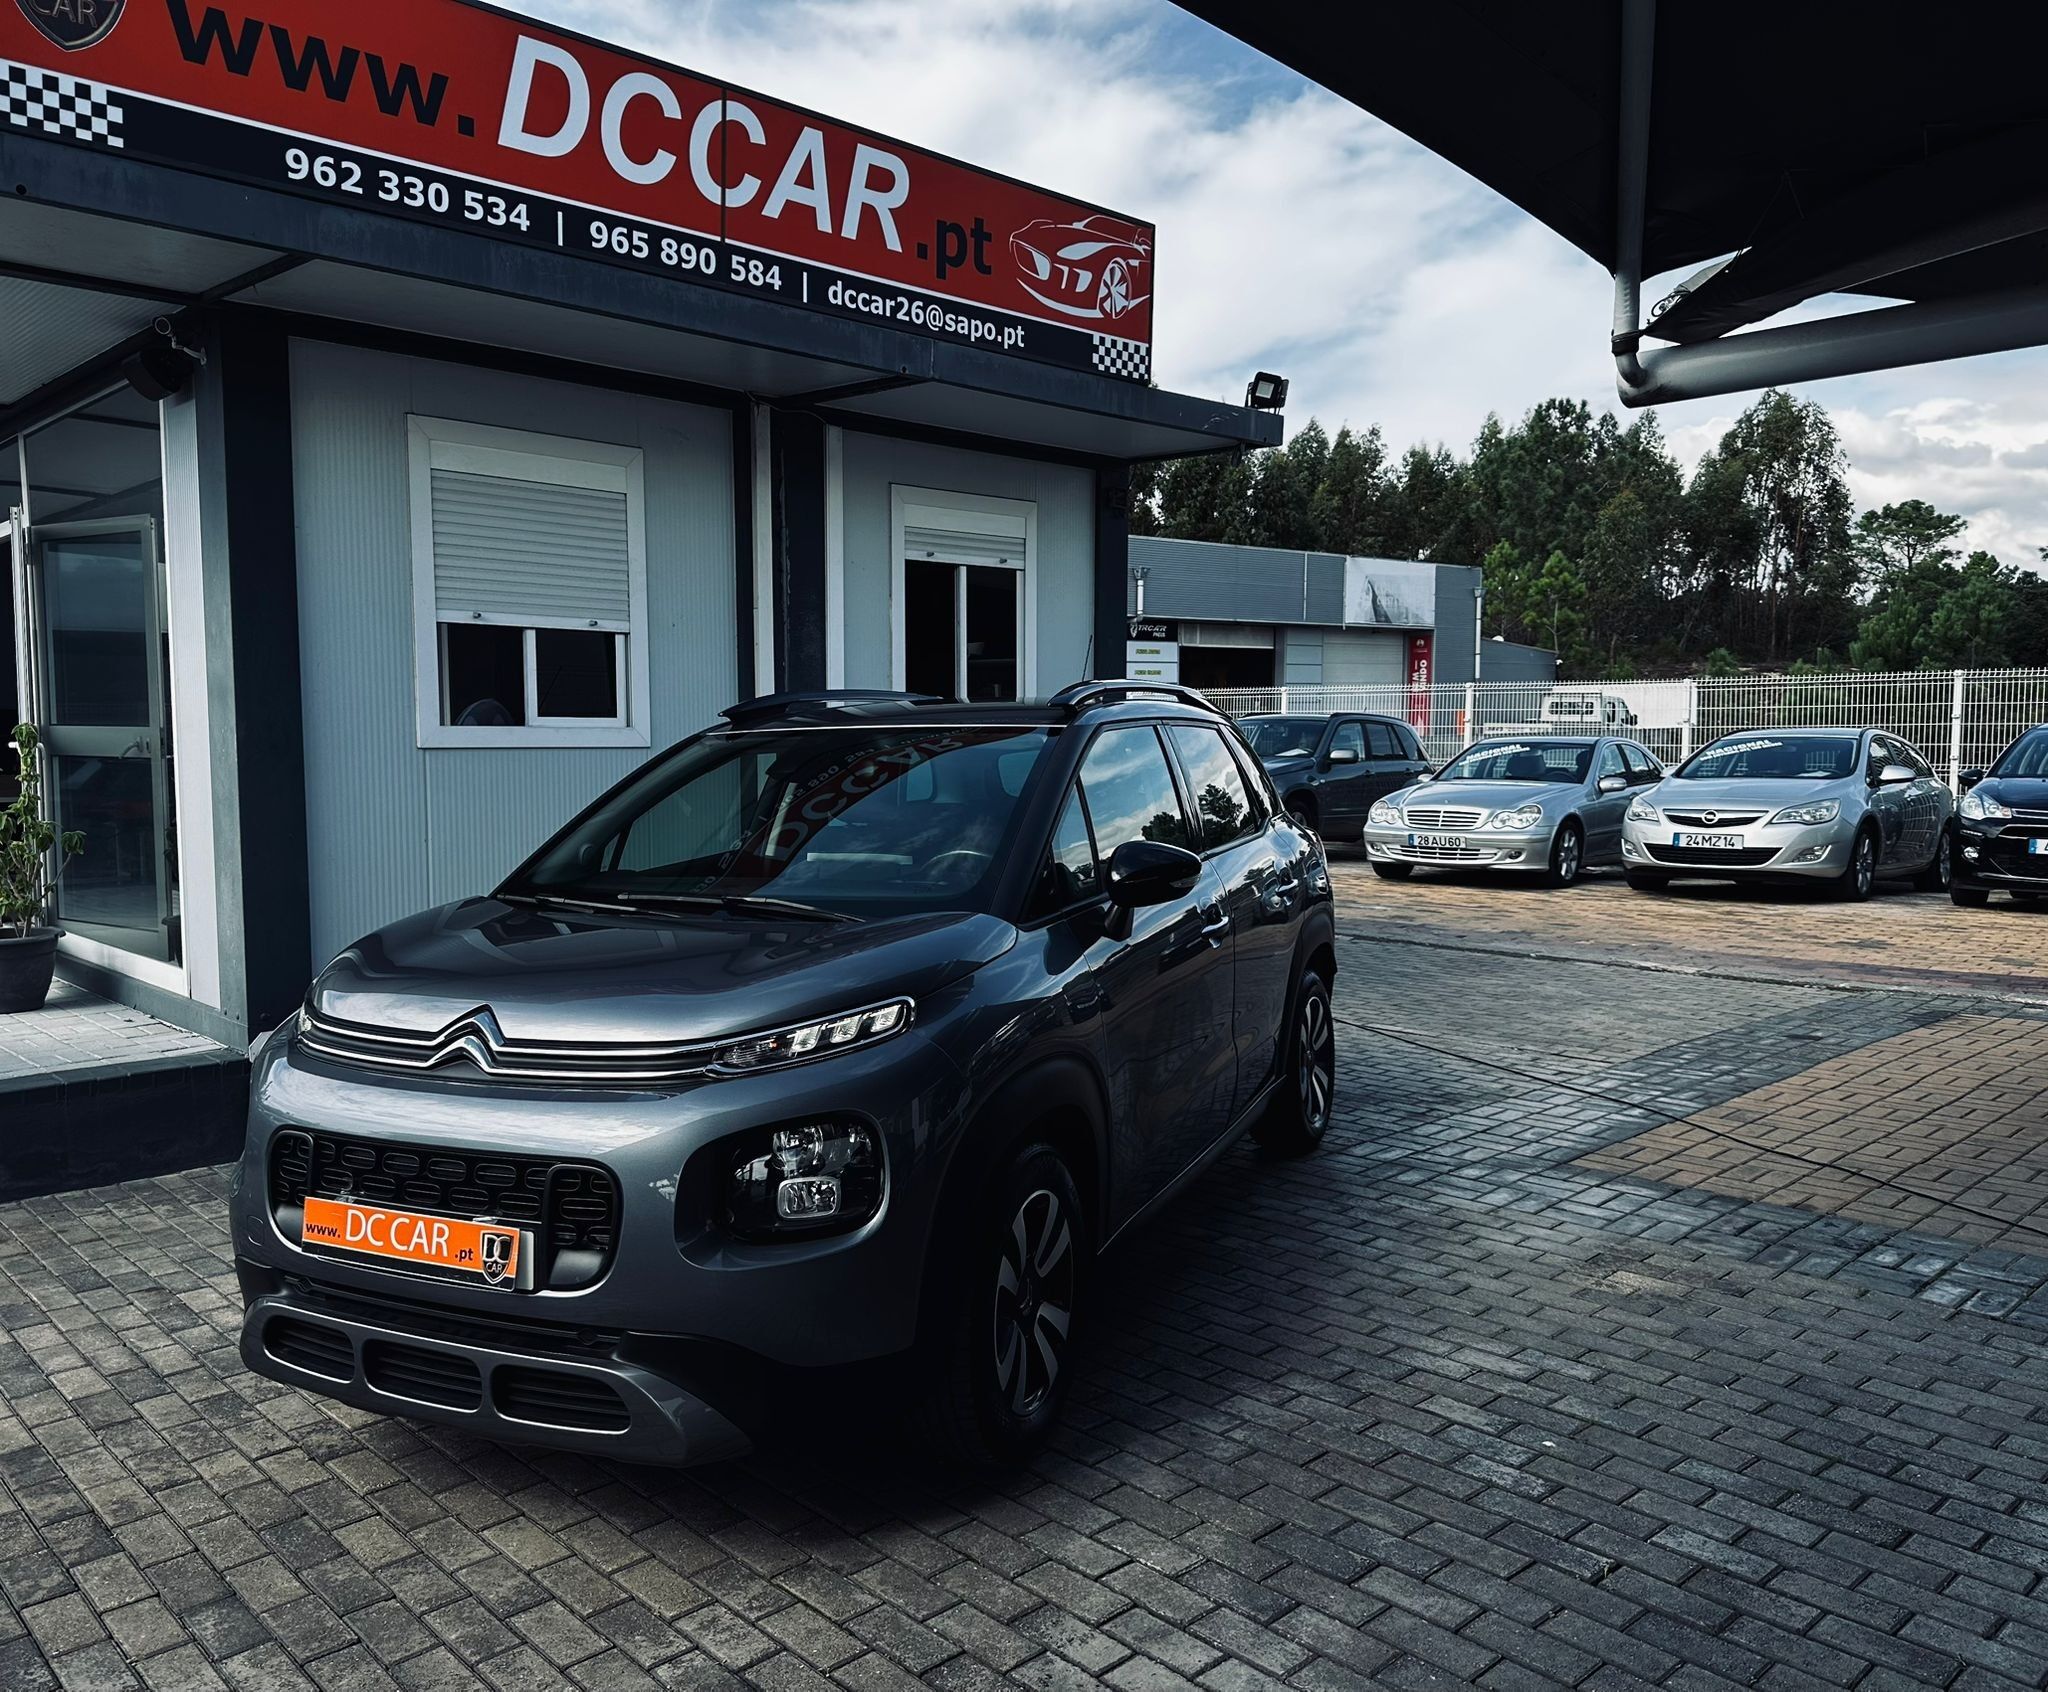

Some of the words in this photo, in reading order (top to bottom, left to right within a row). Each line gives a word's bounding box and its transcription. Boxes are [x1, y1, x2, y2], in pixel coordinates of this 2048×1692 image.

[284, 148, 363, 195] 962
[378, 169, 450, 213] 330
[463, 192, 531, 231] 534
[589, 221, 650, 259] 965
[660, 237, 717, 275] 890
[730, 254, 782, 290] 584
[828, 279, 1025, 349] dccar26@sapo.pt
